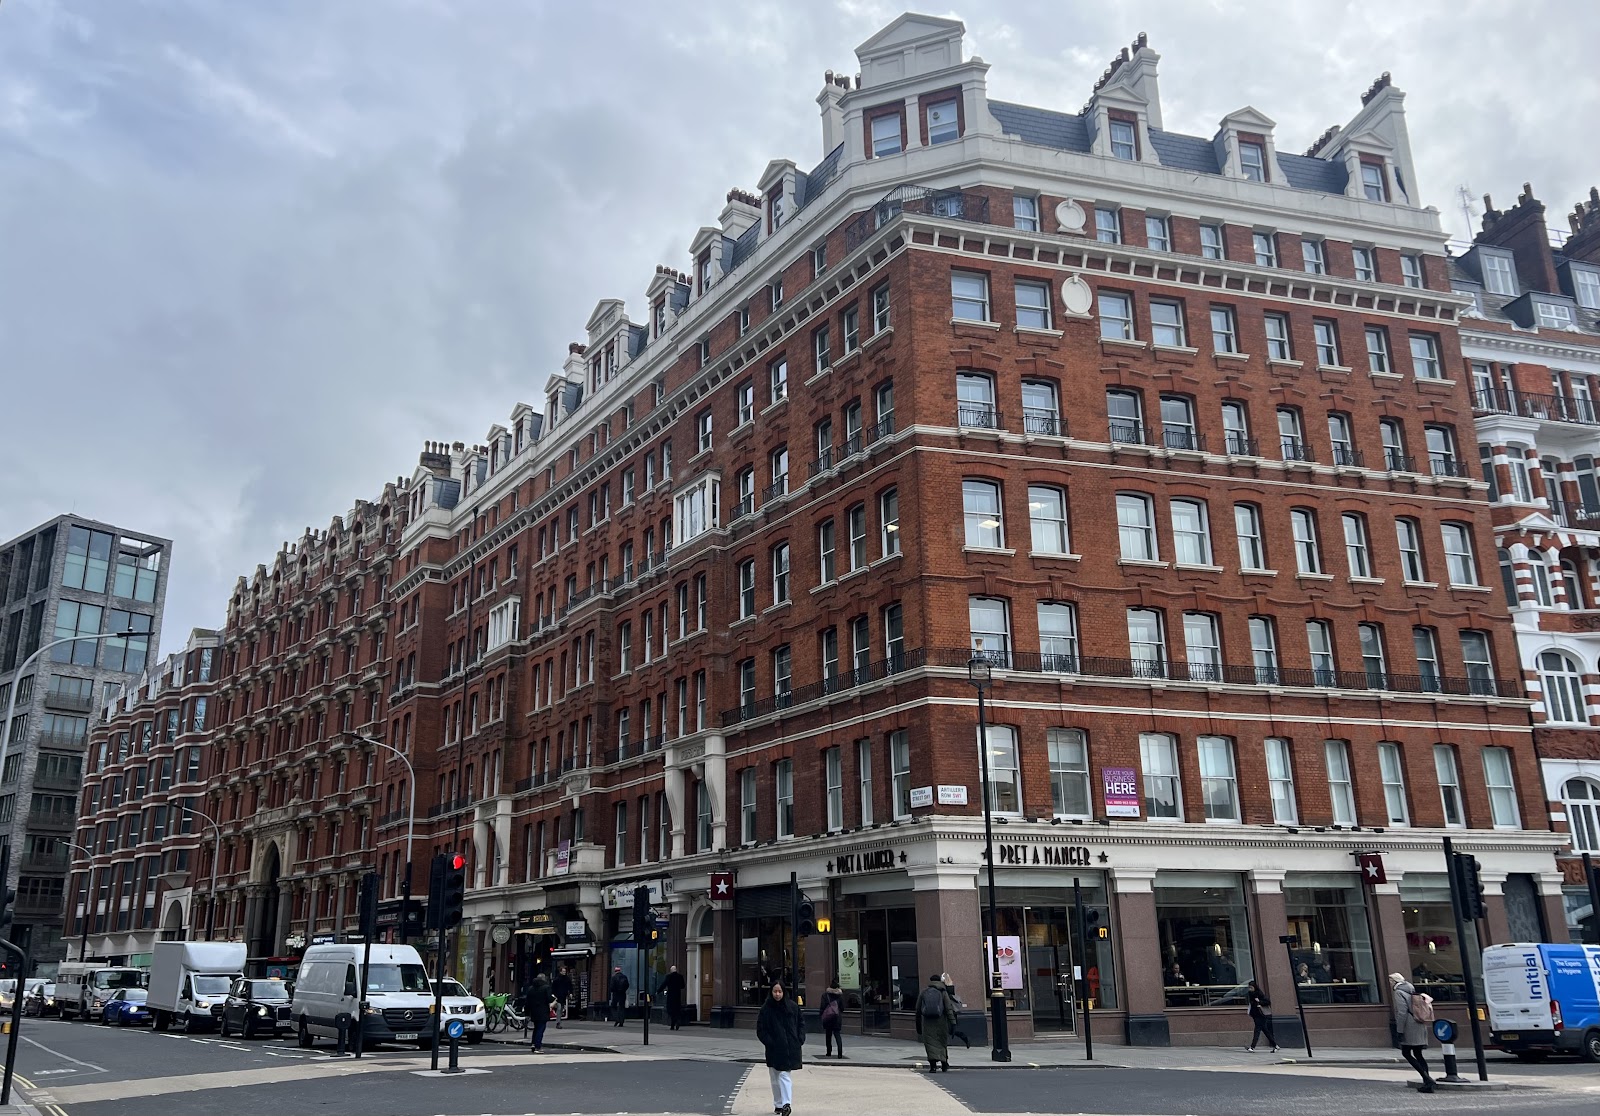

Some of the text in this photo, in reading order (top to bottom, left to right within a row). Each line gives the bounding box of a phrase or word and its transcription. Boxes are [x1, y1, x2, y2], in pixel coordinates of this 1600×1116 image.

[1106, 782, 1136, 794] HERE
[558, 850, 568, 860] HERE
[837, 849, 895, 873] PRET A MANGER
[1000, 844, 1090, 866] PRET A MANGER
[1523, 954, 1542, 999] Initial
